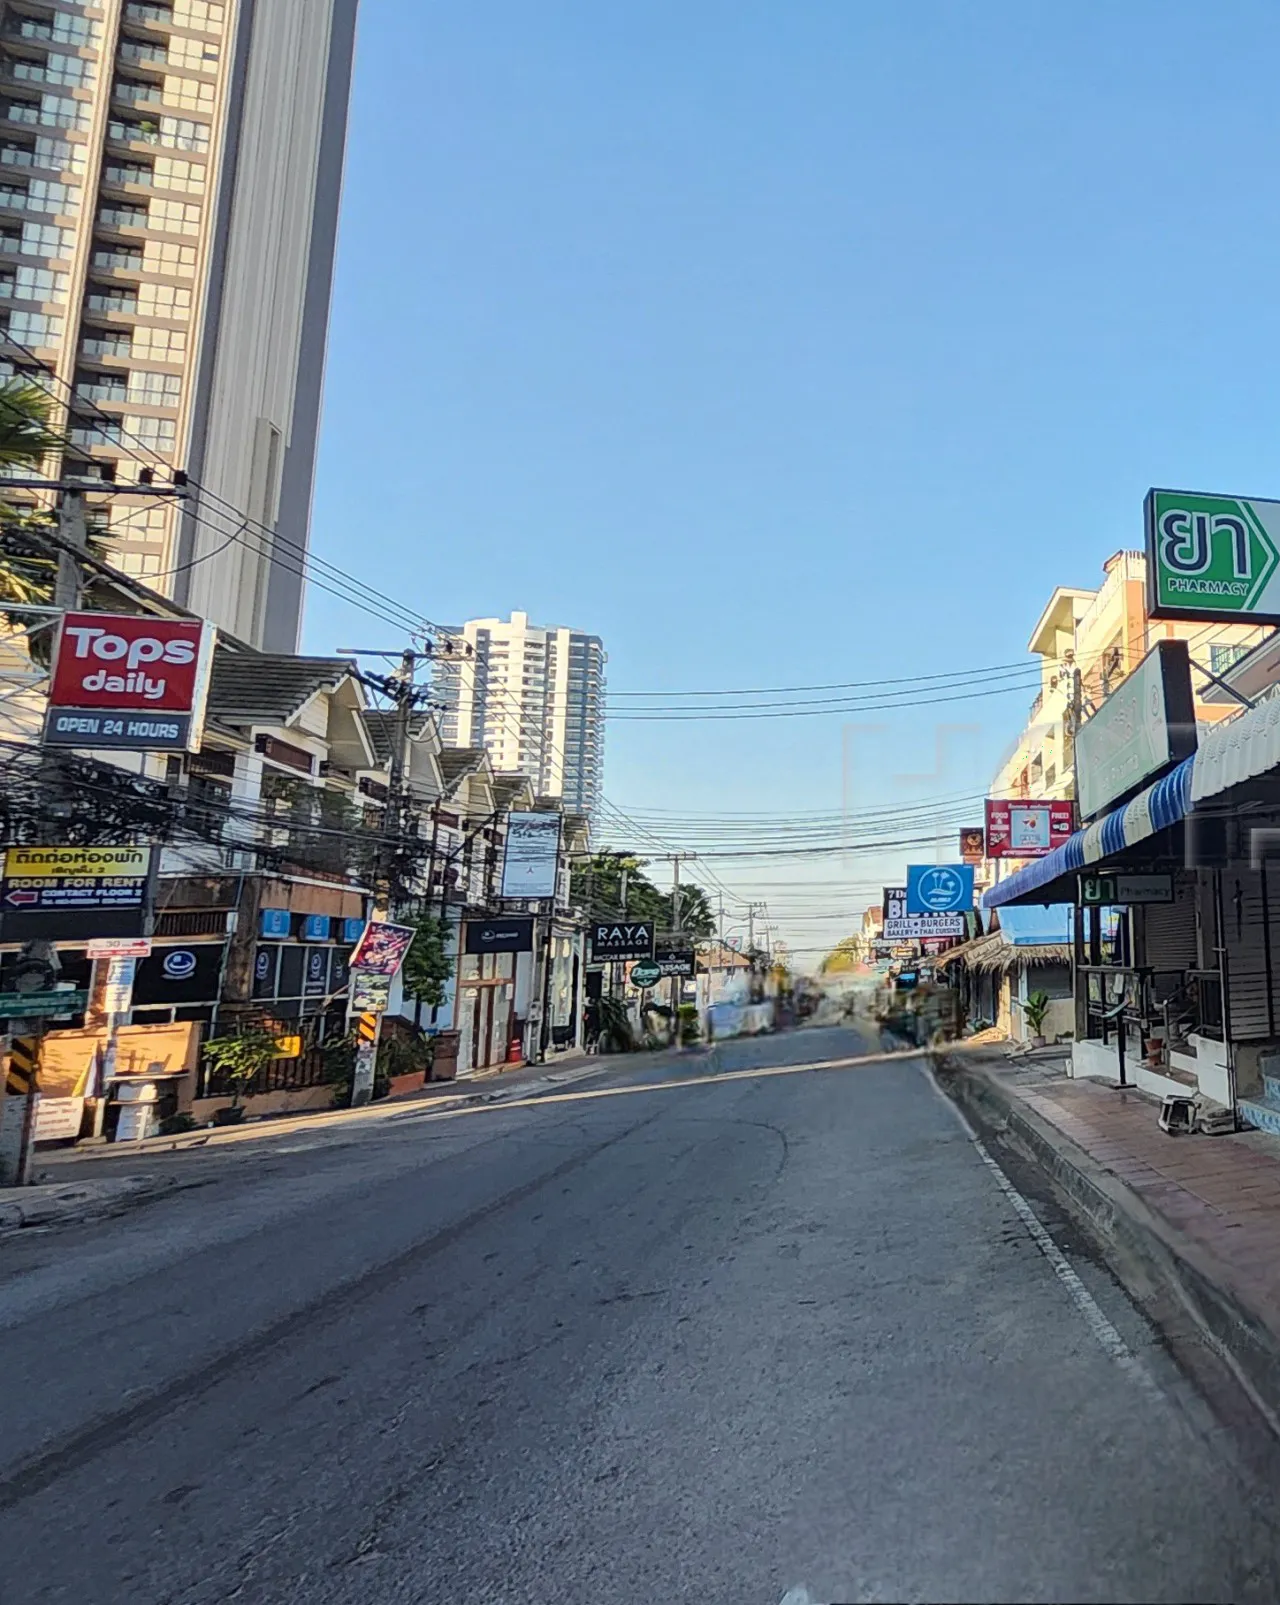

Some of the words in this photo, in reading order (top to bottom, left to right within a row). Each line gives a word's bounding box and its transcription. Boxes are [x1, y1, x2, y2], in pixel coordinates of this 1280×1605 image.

[1159, 509, 1251, 578] ยา
[1168, 577, 1249, 596] PHARMACY
[65, 626, 196, 669] Tops
[81, 669, 166, 700] daily
[56, 716, 99, 735] OPEN
[102, 719, 124, 736] 24
[127, 721, 180, 740] HOURS
[8, 878, 59, 889] ROOM
[63, 877, 96, 888] FOR
[102, 877, 146, 888] RENT
[1084, 877, 1115, 901] ยา
[41, 889, 94, 897] CONTACT
[96, 889, 133, 897] FLOOR
[1120, 886, 1170, 897] Pharmacy
[887, 920, 912, 929] GRILL
[920, 918, 961, 928] BURGERS
[597, 925, 649, 940] RAYA
[887, 929, 914, 937] BAKERY
[597, 938, 649, 947] MASSAGE
